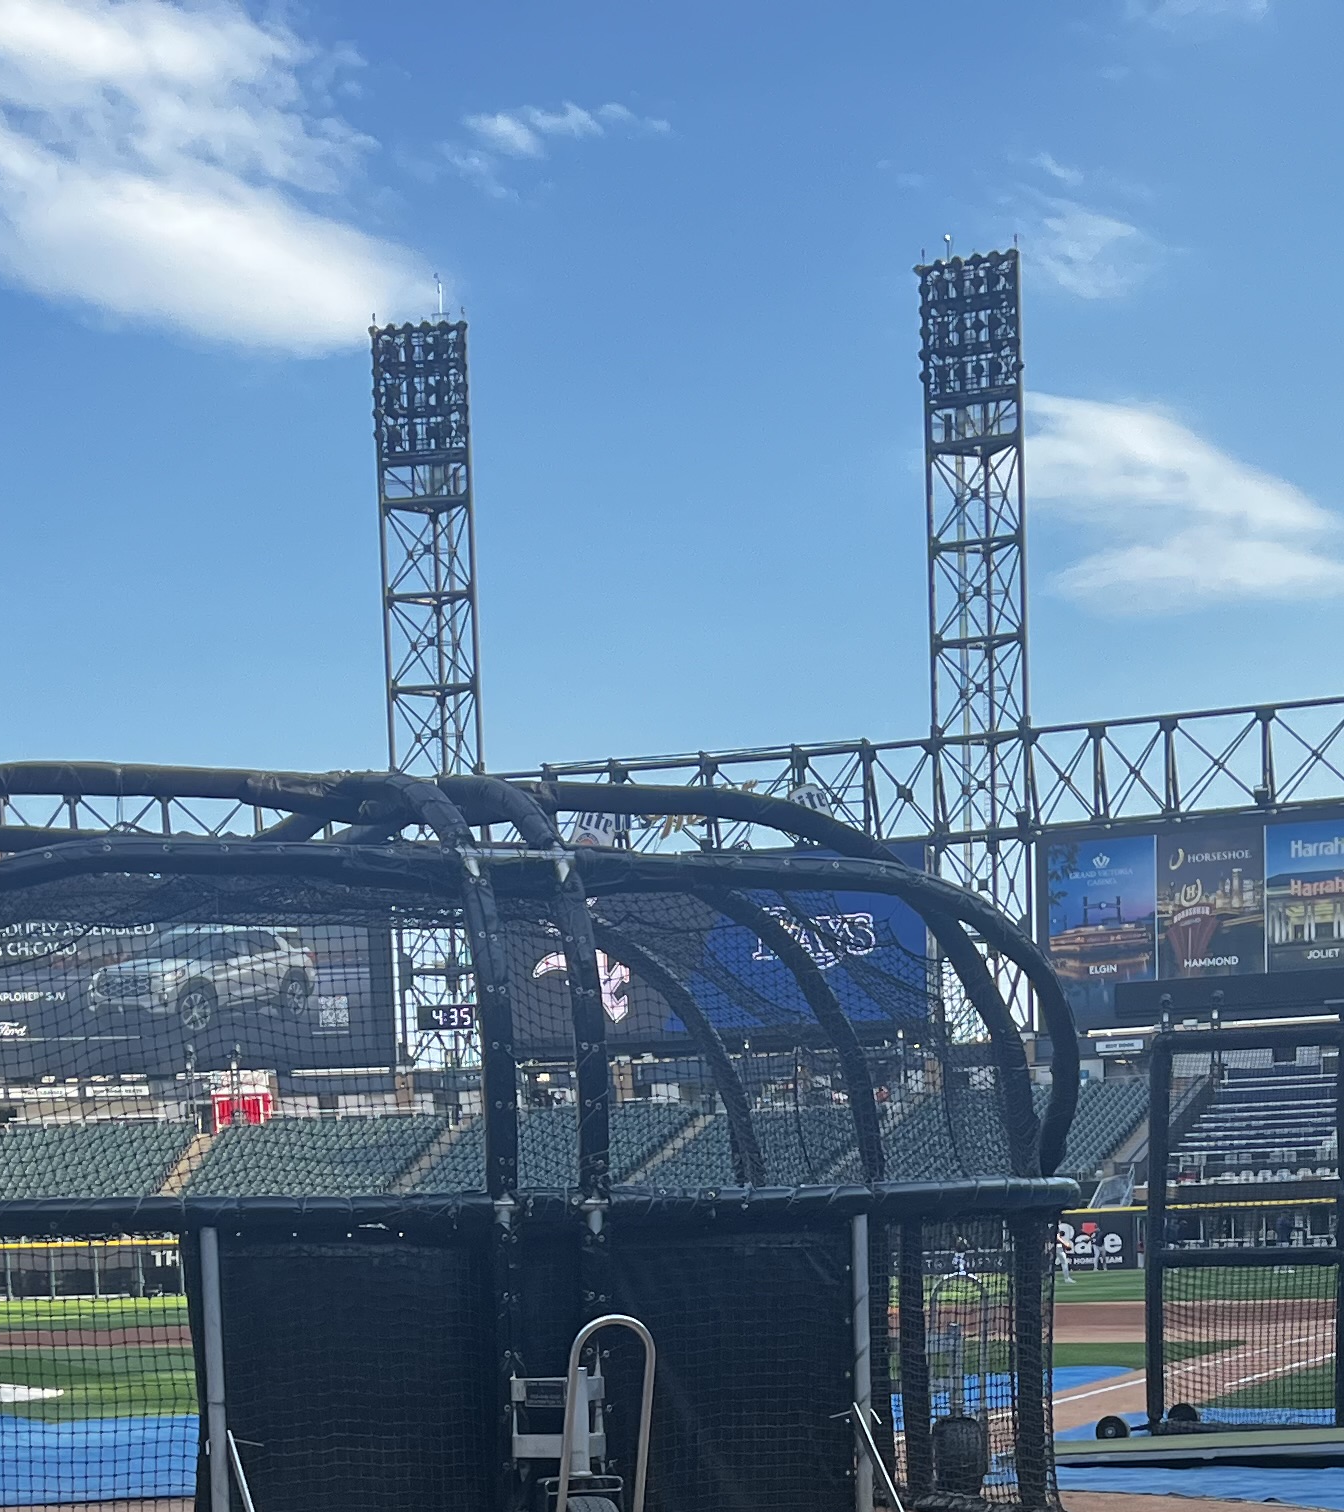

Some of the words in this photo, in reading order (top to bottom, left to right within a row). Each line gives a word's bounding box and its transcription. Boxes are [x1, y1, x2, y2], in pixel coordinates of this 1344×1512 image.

[1187, 850, 1251, 863] HORSESHOE
[1307, 948, 1340, 960] JOLIET
[1183, 956, 1239, 968] HAMMOND
[1089, 964, 1118, 975] ELGIN
[432, 1007, 471, 1026] 4:35
